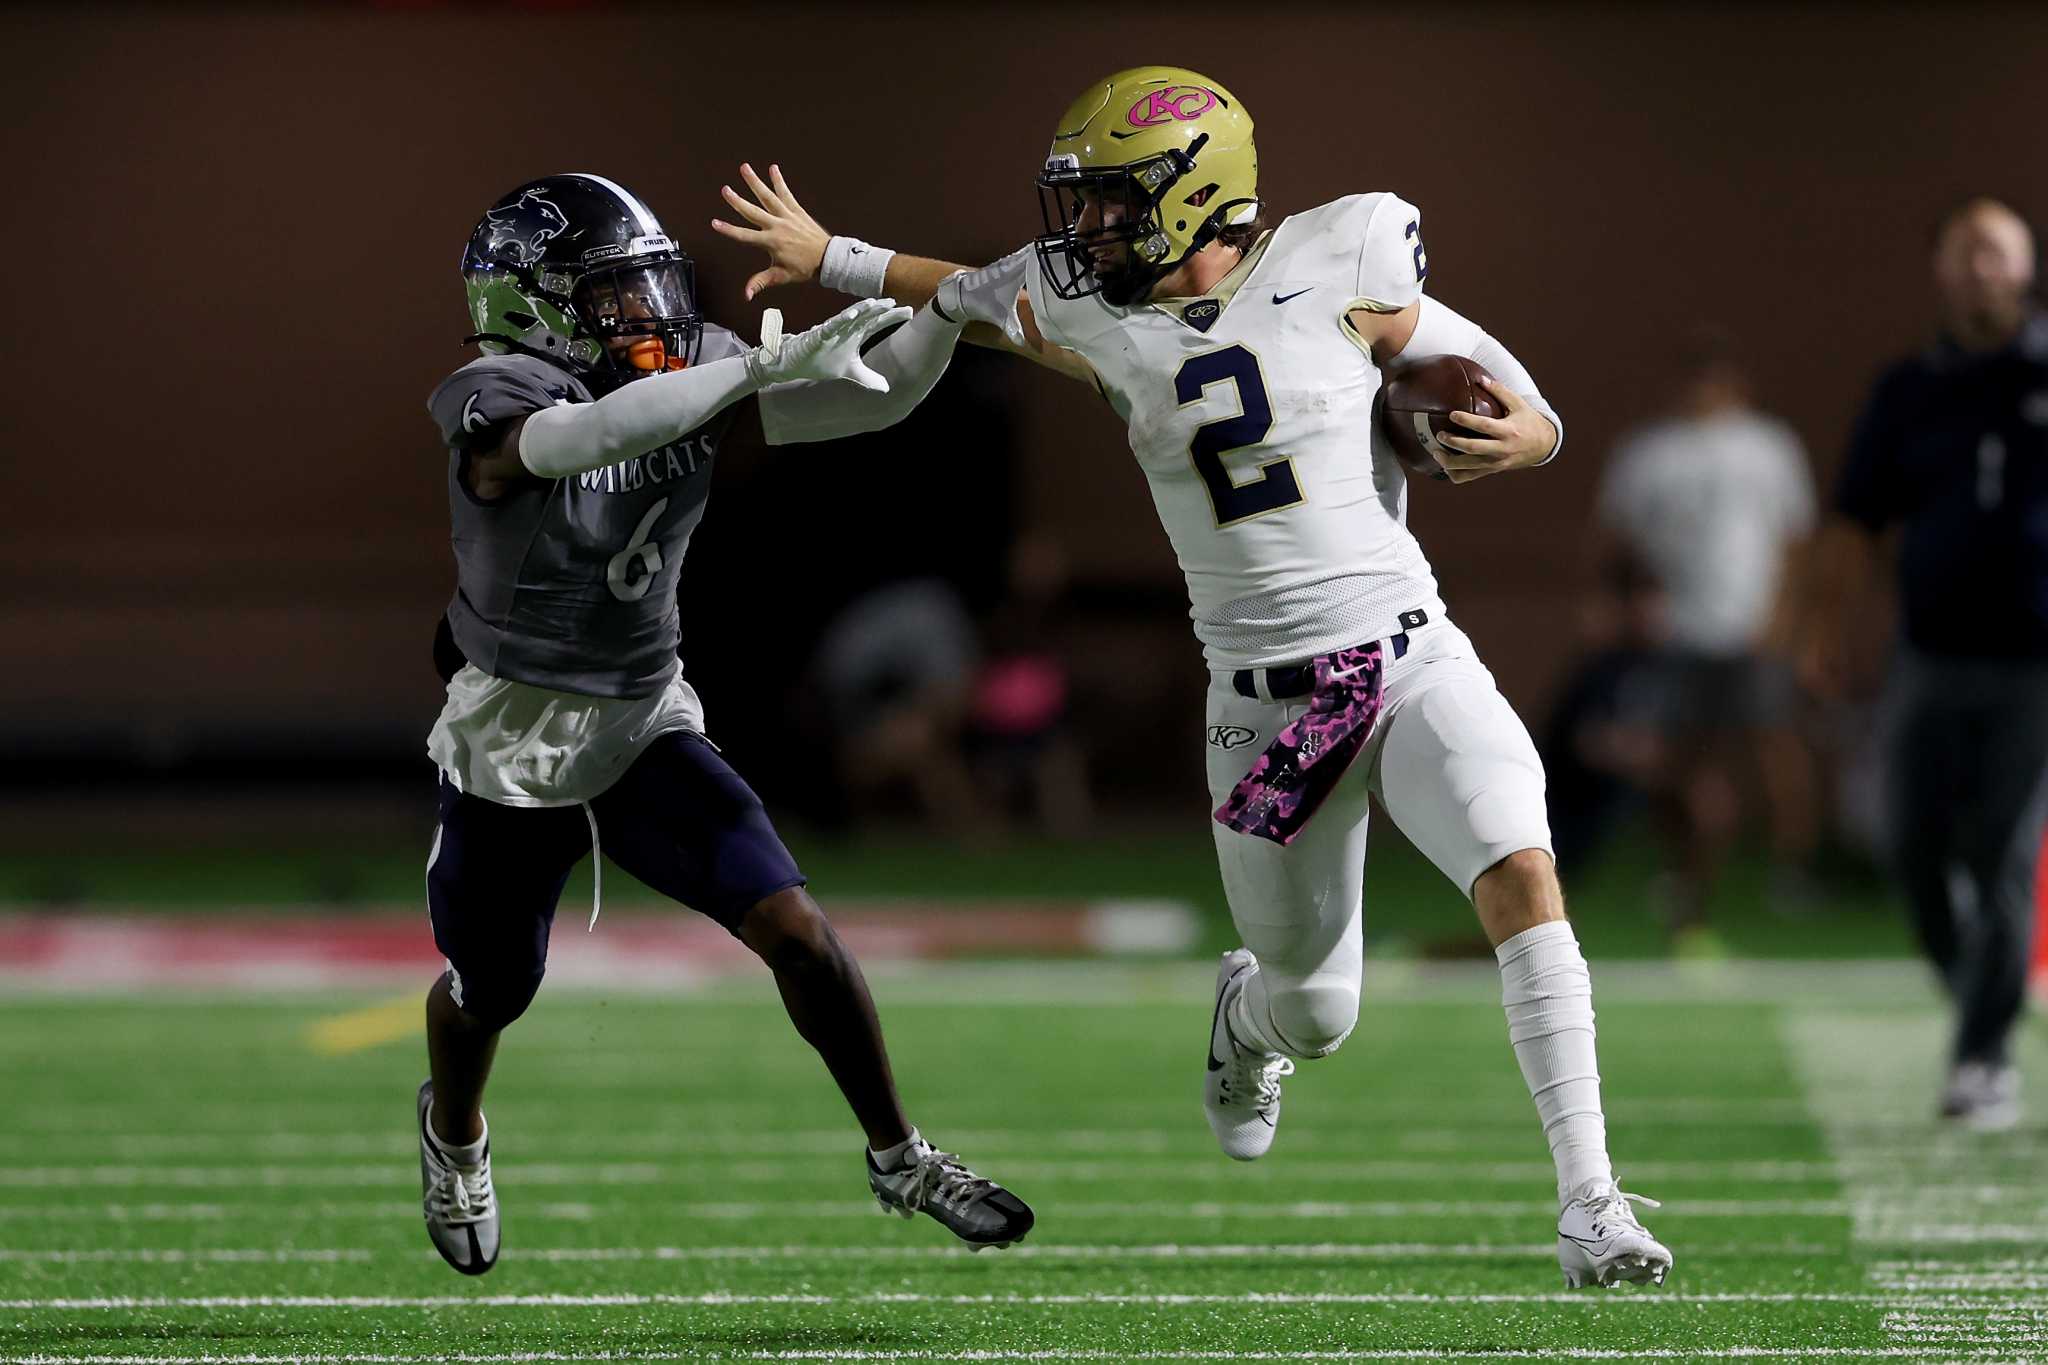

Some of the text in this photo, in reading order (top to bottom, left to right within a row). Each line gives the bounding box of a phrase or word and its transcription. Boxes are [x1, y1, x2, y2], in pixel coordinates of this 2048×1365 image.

[642, 238, 668, 247] TRUST
[1405, 219, 1428, 283] 2
[579, 434, 713, 493] WILDCATS
[1173, 341, 1308, 529] 2
[607, 497, 668, 601] 6
